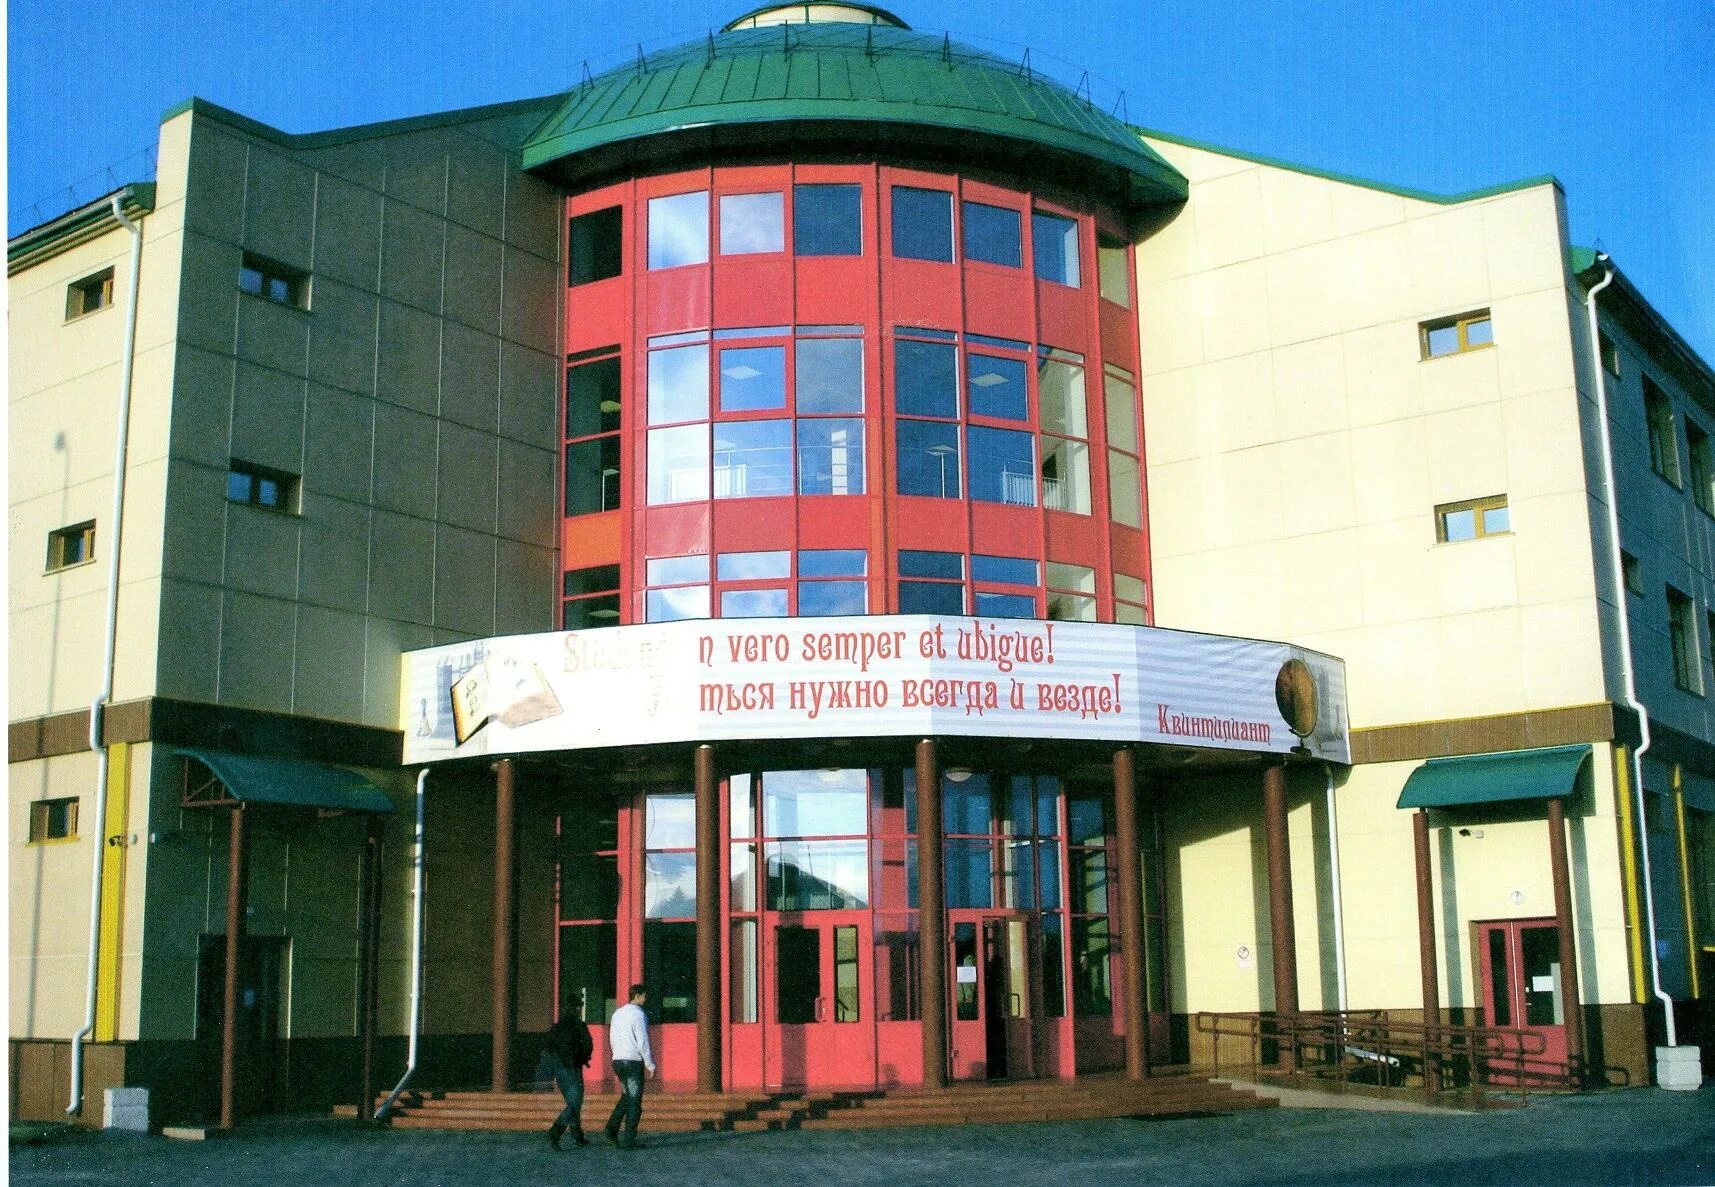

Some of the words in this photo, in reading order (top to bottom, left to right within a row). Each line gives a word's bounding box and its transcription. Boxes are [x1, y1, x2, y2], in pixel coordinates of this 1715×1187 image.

[728, 635, 789, 662] vero
[803, 632, 906, 672] semper
[919, 623, 946, 659] et
[699, 683, 774, 715] ться
[790, 680, 888, 719] нужно
[903, 680, 998, 716] всегда
[1011, 679, 1024, 709] и
[1039, 674, 1120, 720] везде!
